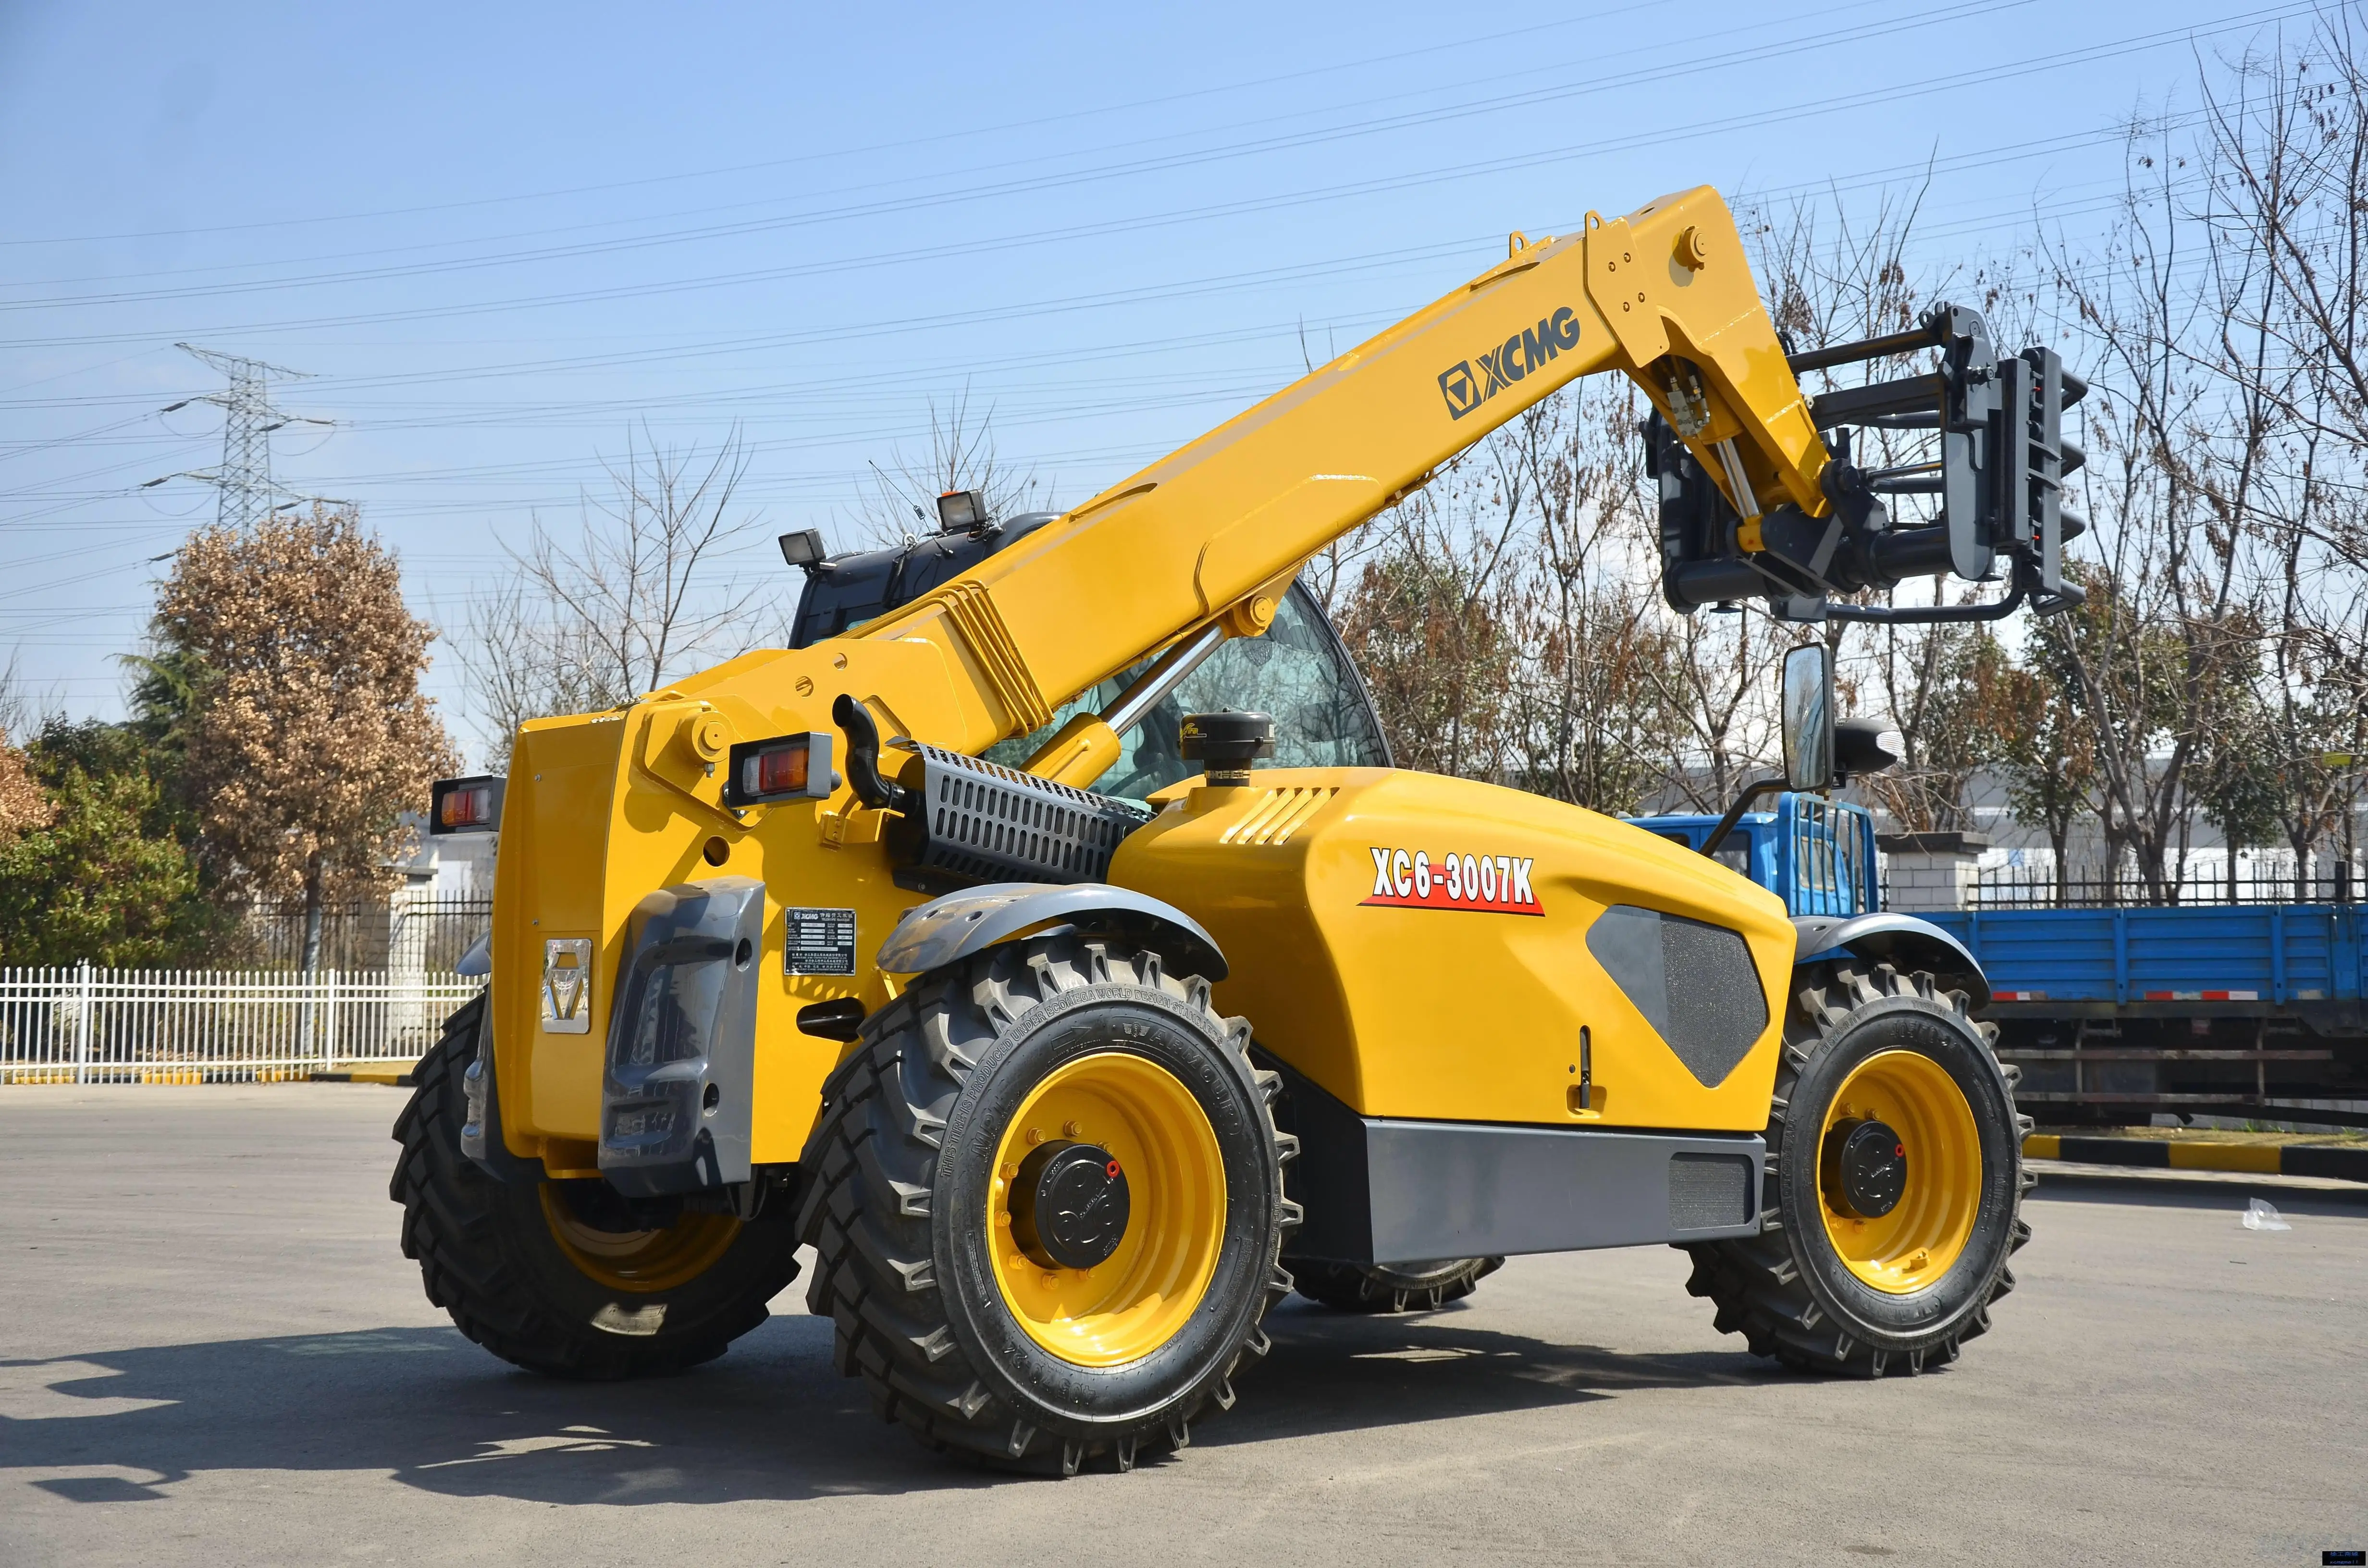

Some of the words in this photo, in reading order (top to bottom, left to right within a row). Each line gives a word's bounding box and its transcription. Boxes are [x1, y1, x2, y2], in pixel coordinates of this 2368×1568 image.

[1475, 306, 1580, 403] XCMG
[1369, 846, 1535, 906] XC6-3007K
[1044, 989, 1096, 1017] ECOMEGA
[1096, 988, 1132, 999] WORLD
[1134, 988, 1171, 1008] DESIGN
[1010, 1011, 1047, 1041] UNDER
[1172, 1000, 1223, 1047] STANDARDS
[966, 1038, 1013, 1101] PRODUCED
[960, 1099, 973, 1115] IS
[948, 1113, 967, 1143] TIRE
[941, 1146, 957, 1177] THIS
